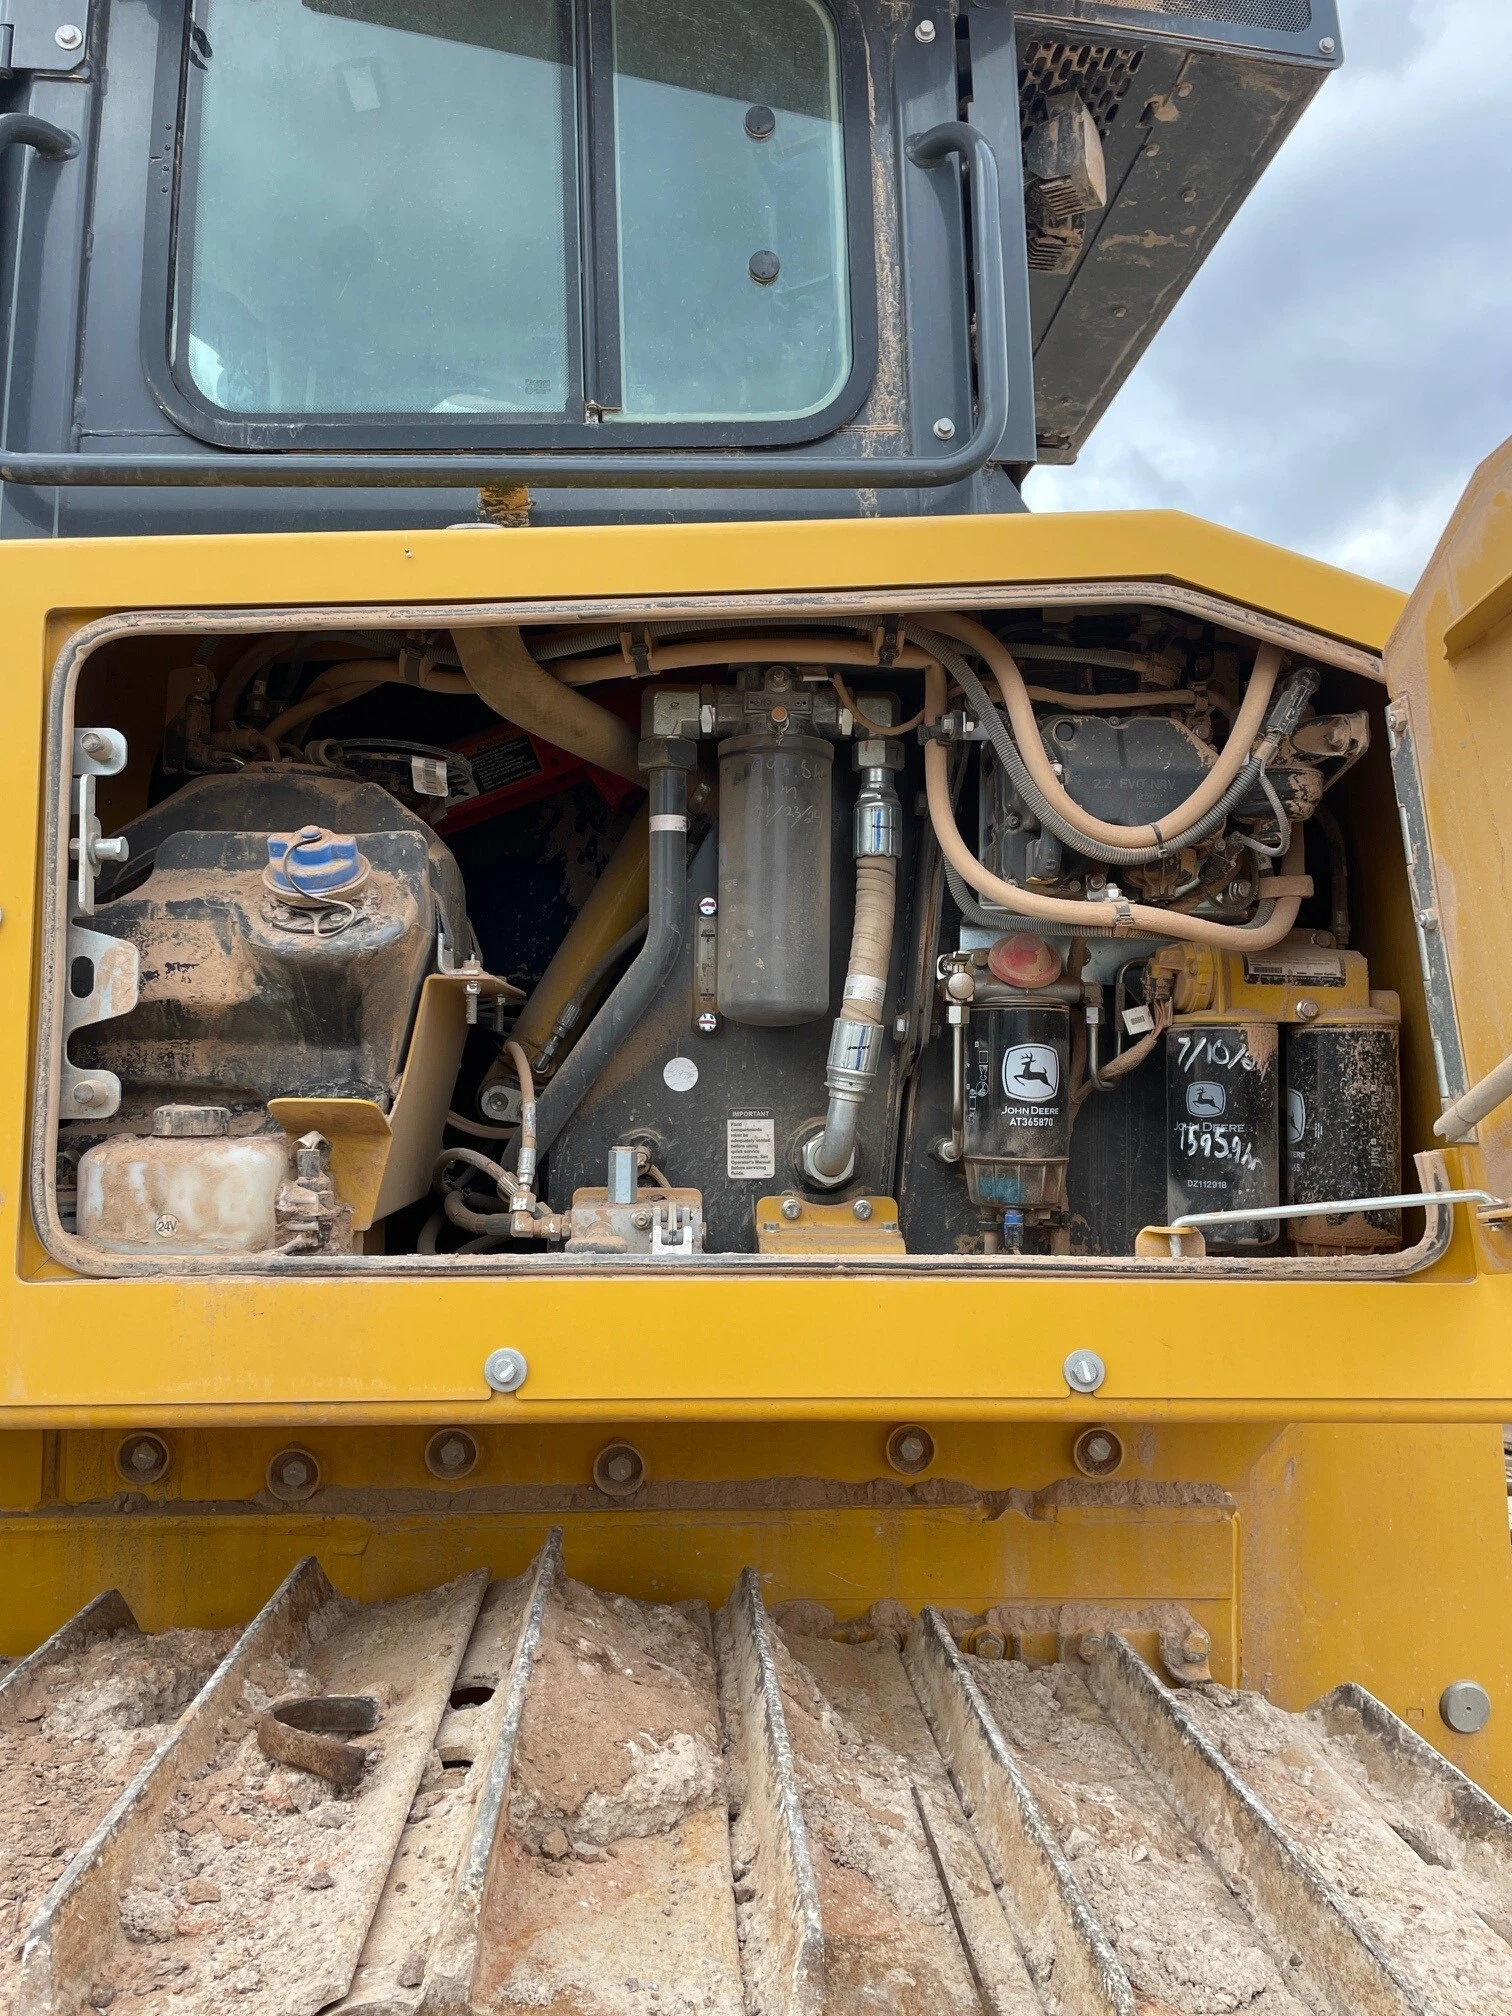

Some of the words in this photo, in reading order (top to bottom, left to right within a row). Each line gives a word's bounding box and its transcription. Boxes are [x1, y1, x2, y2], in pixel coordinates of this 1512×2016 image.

[1001, 1105, 1029, 1115] JOHN
[1030, 1105, 1059, 1115] DEERE
[1009, 1117, 1053, 1127] AT365870
[1202, 1122, 1246, 1133] DEERE
[157, 1220, 178, 1232] 24V
